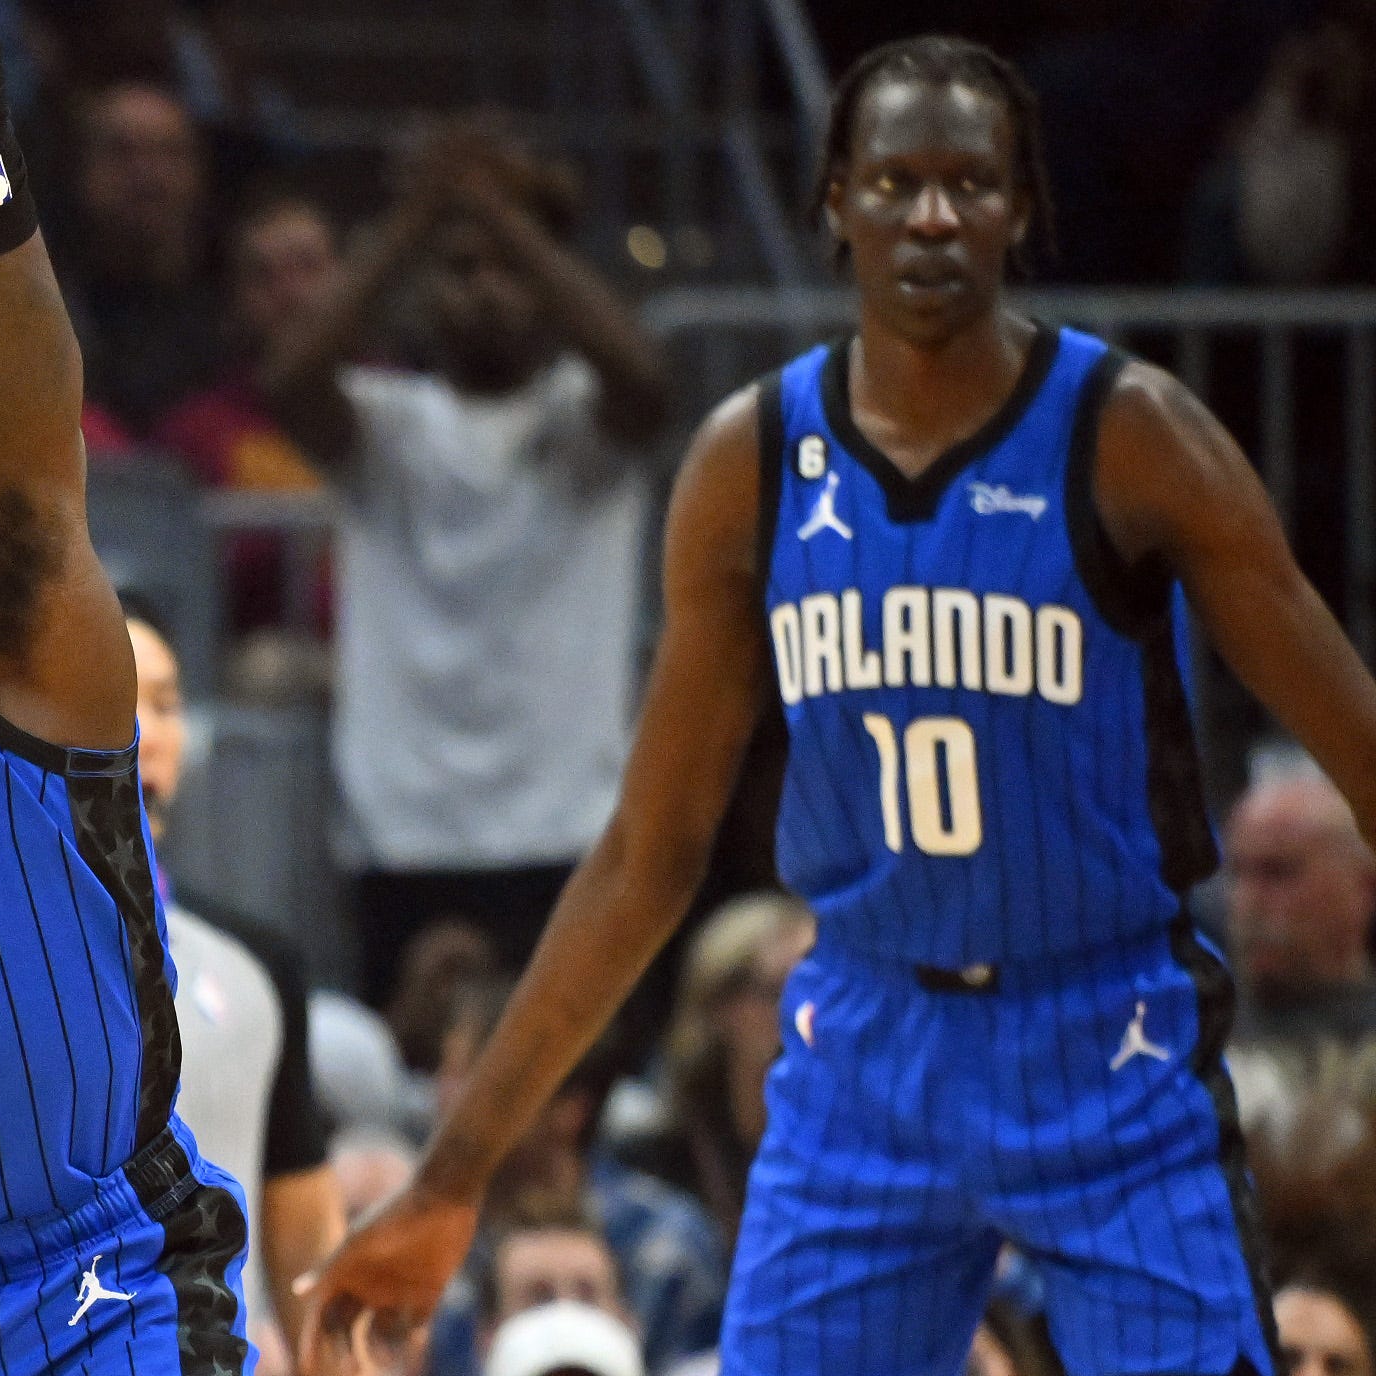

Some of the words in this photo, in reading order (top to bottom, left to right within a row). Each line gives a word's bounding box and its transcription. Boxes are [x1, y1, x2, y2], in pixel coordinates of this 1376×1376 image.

[797, 435, 827, 479] 6
[770, 585, 1084, 706] ORLANDO
[862, 711, 984, 858] 10
